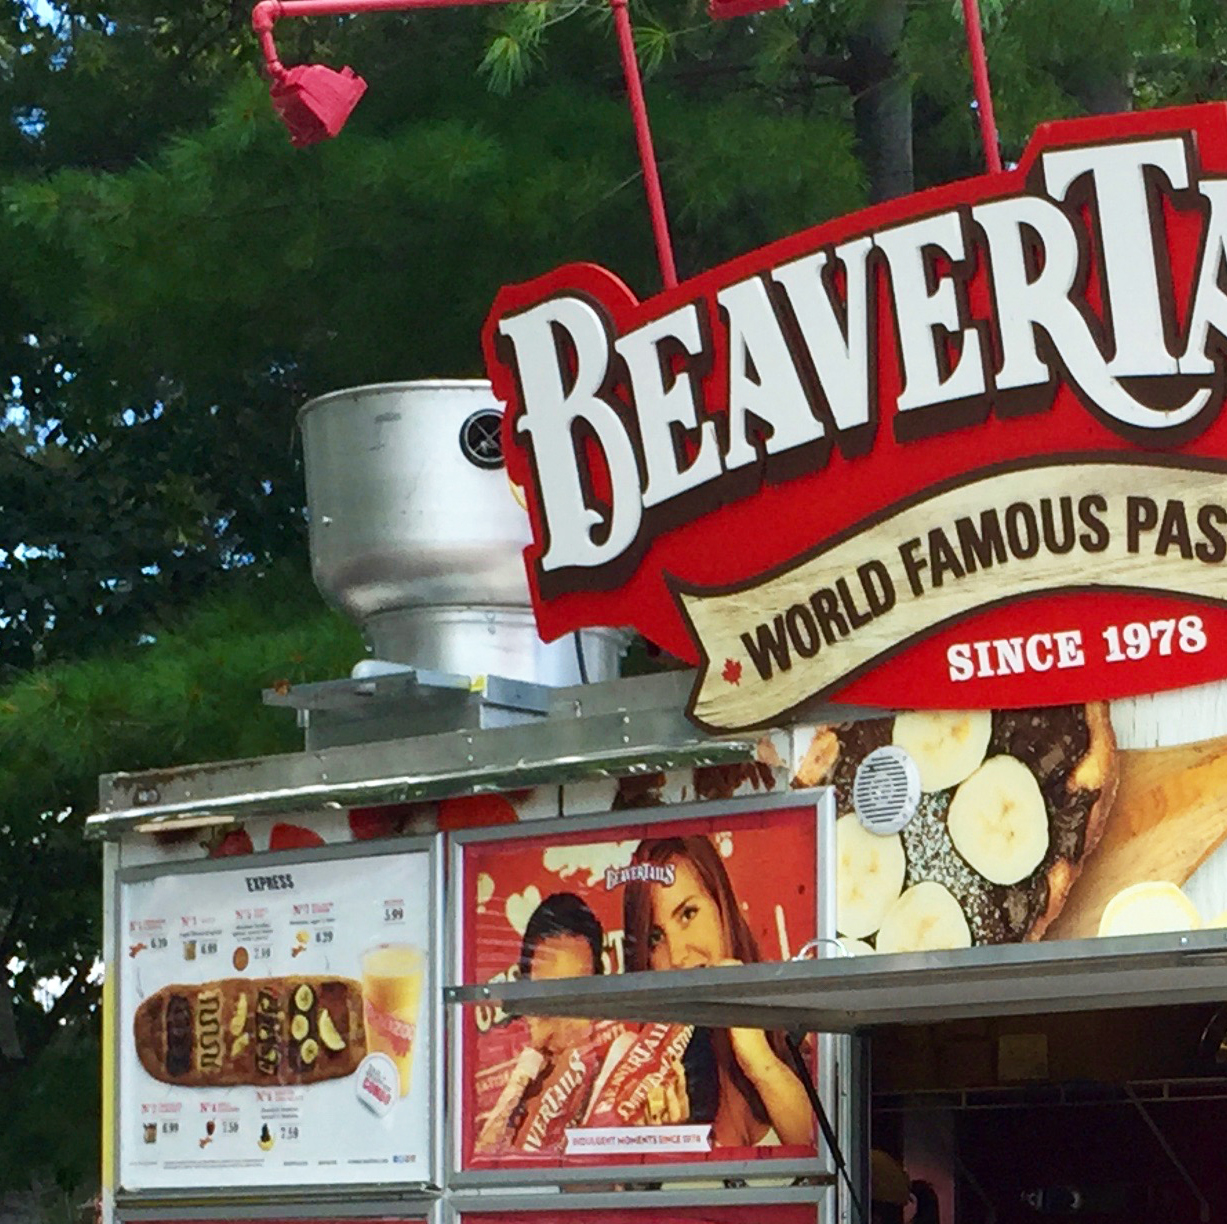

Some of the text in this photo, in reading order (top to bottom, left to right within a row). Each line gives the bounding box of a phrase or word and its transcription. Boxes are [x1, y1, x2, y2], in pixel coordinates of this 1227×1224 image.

[741, 559, 896, 682] WORLD
[899, 495, 1111, 597] FAMOUS
[947, 615, 1208, 682] SINCE 1978
[245, 873, 294, 892] EXPRESS
